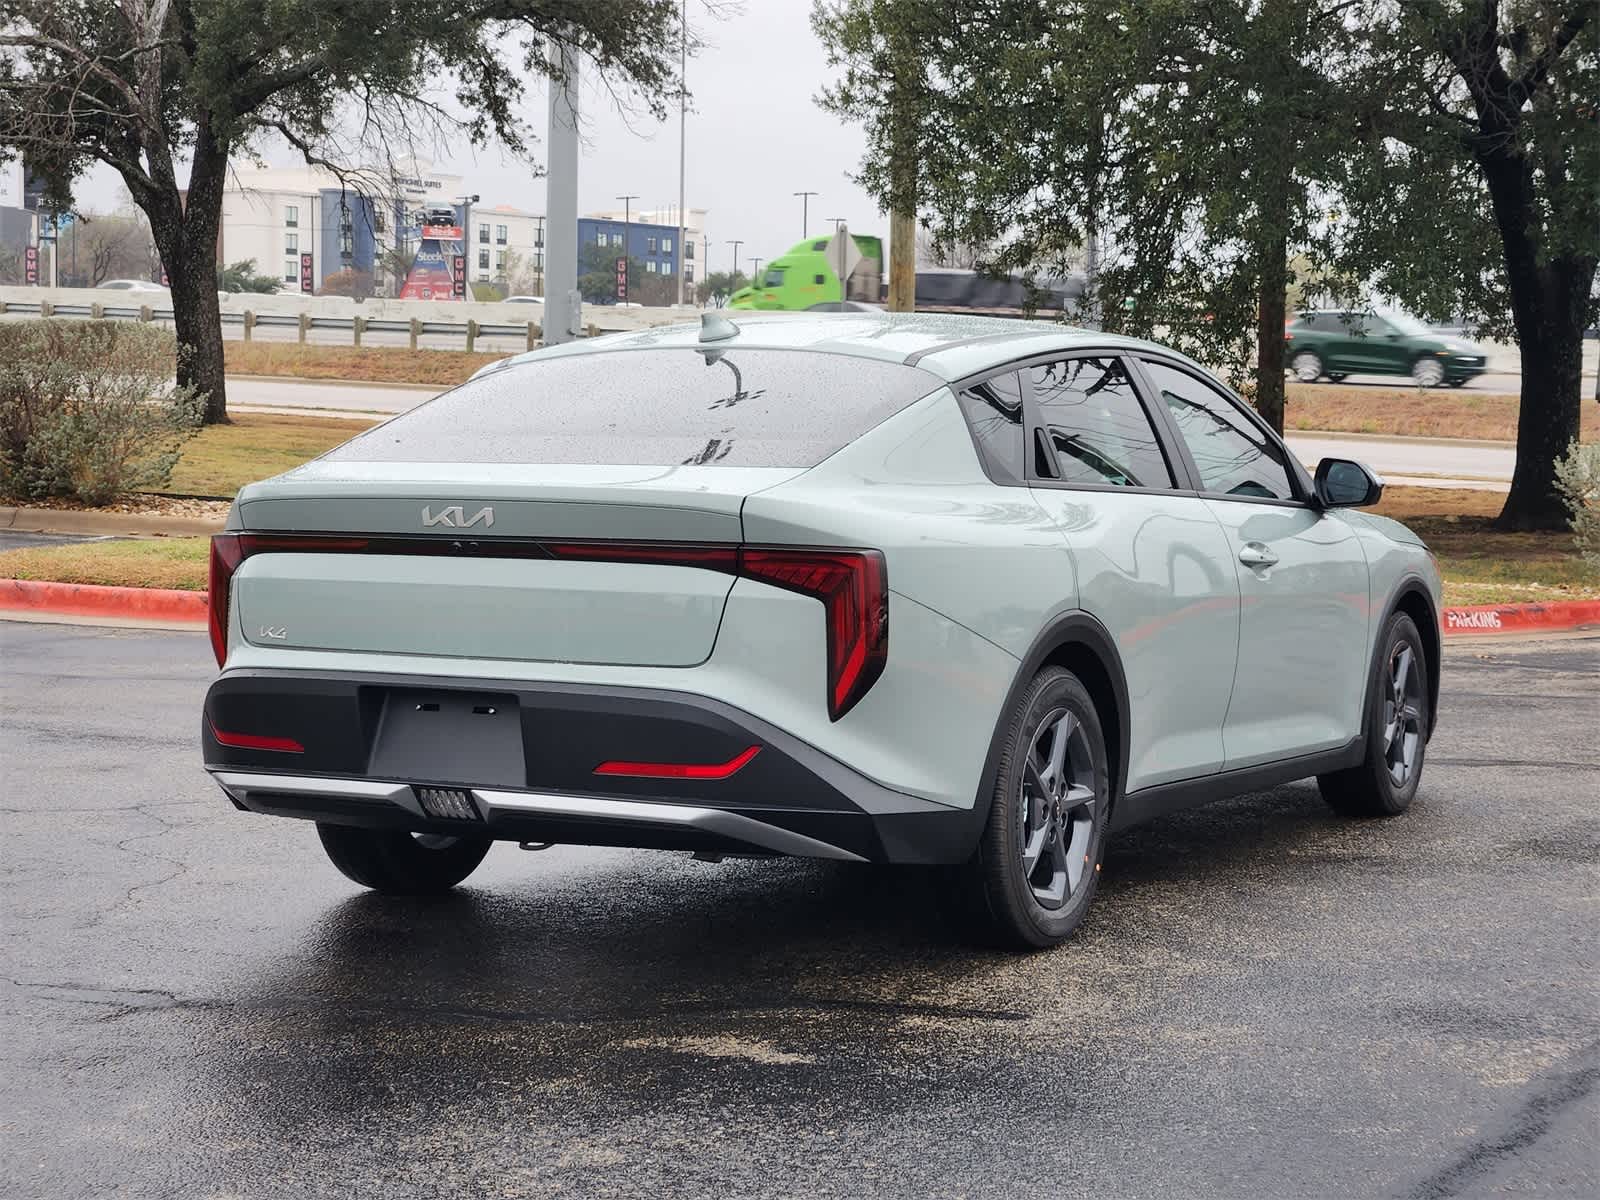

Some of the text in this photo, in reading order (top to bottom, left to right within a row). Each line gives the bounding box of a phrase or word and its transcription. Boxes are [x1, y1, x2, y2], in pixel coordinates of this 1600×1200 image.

[26, 250, 36, 282] GMC
[302, 255, 312, 290] GMC
[455, 257, 465, 293] GMC
[616, 260, 626, 297] GMC
[422, 506, 495, 529] KIA
[259, 625, 287, 640] K4
[1447, 611, 1502, 628] PARKING
